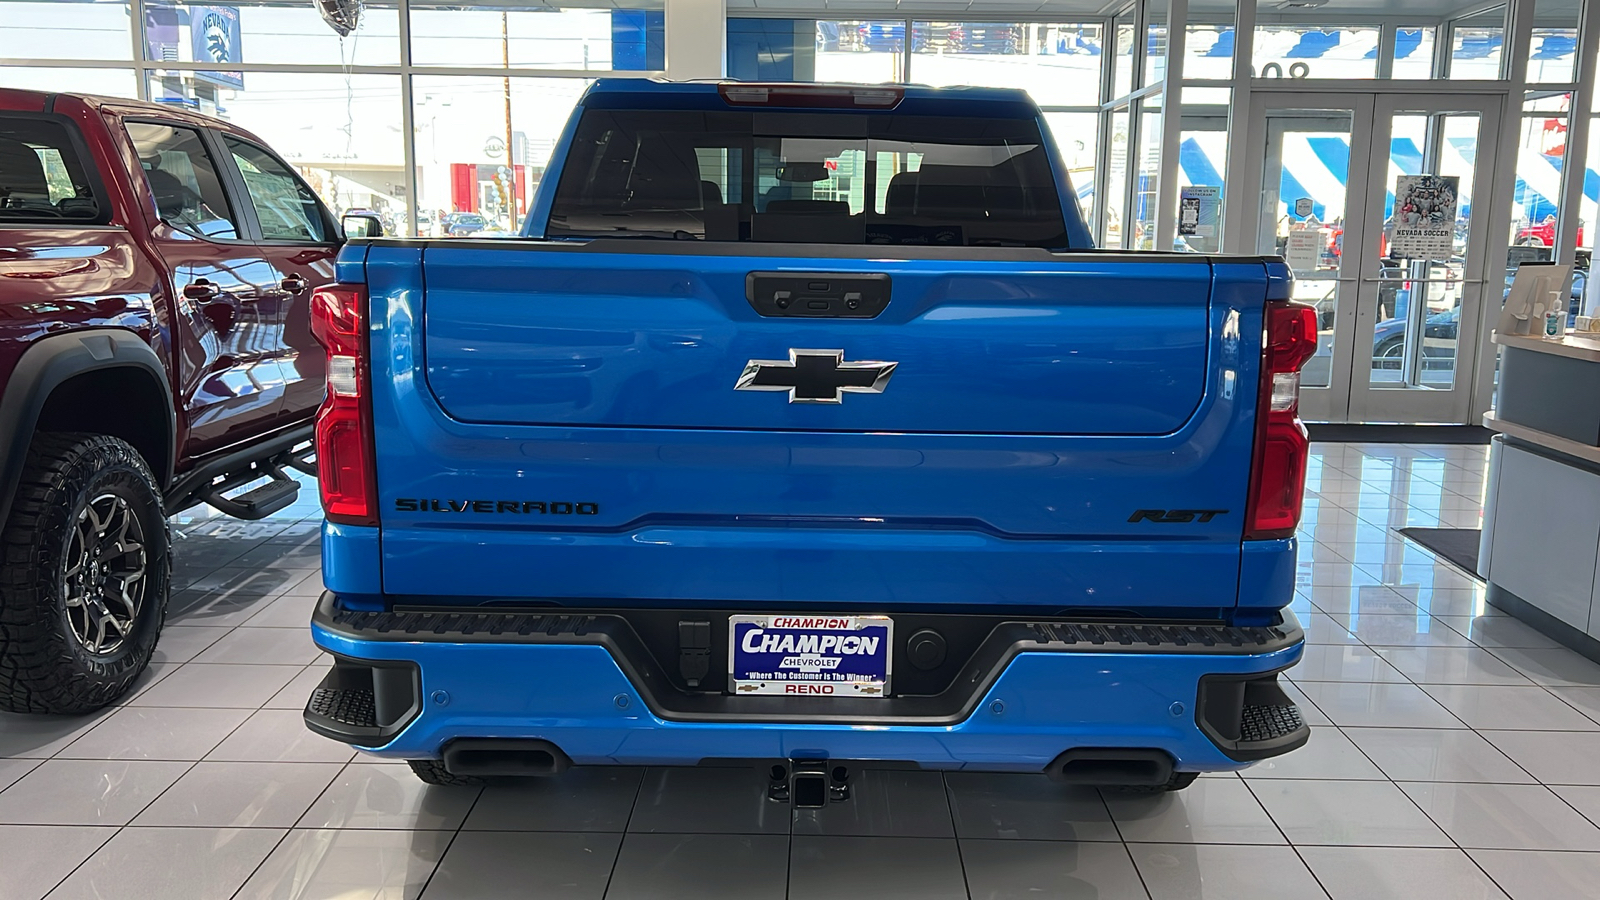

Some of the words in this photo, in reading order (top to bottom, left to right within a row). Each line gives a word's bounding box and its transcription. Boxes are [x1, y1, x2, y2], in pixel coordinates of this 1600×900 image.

[203, 13, 231, 40] NEVADA
[395, 498, 599, 515] SILVERADO
[1127, 509, 1230, 523] RST
[773, 617, 849, 629] CHAMPION
[741, 629, 880, 655] CHAMPION
[783, 658, 837, 667] CHEVROLET
[774, 672, 786, 680] The
[788, 672, 820, 680] Customer
[833, 673, 845, 681] The
[785, 684, 834, 695] RENO
